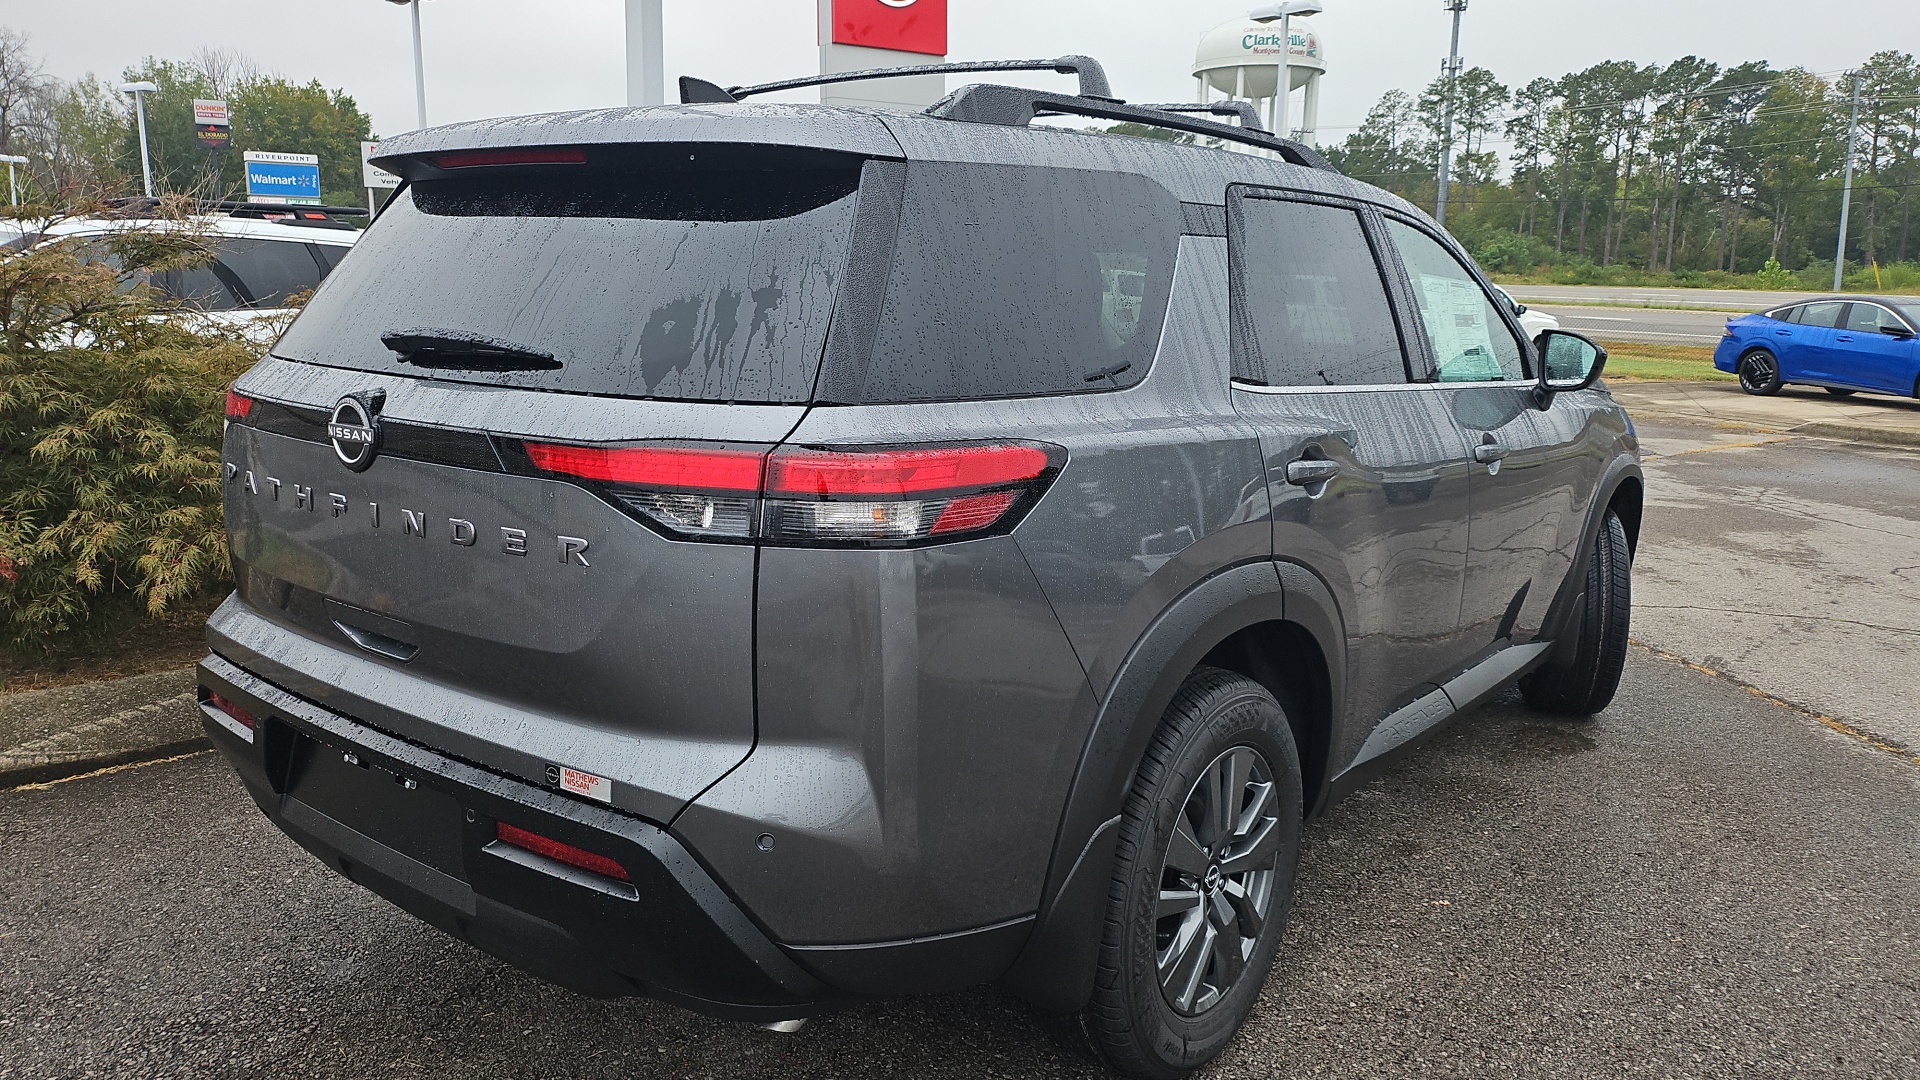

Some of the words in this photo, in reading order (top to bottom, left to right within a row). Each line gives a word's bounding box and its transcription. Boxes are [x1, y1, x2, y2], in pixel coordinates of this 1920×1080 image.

[1242, 34, 1306, 49] Clarkville
[1253, 47, 1288, 55] Montgom
[1289, 47, 1306, 57] County
[251, 174, 297, 185] Walmart
[328, 424, 372, 442] NISSAN
[225, 462, 591, 567] PATHFINDER
[564, 768, 599, 786] MATHEWS
[564, 776, 590, 791] NISSAN
